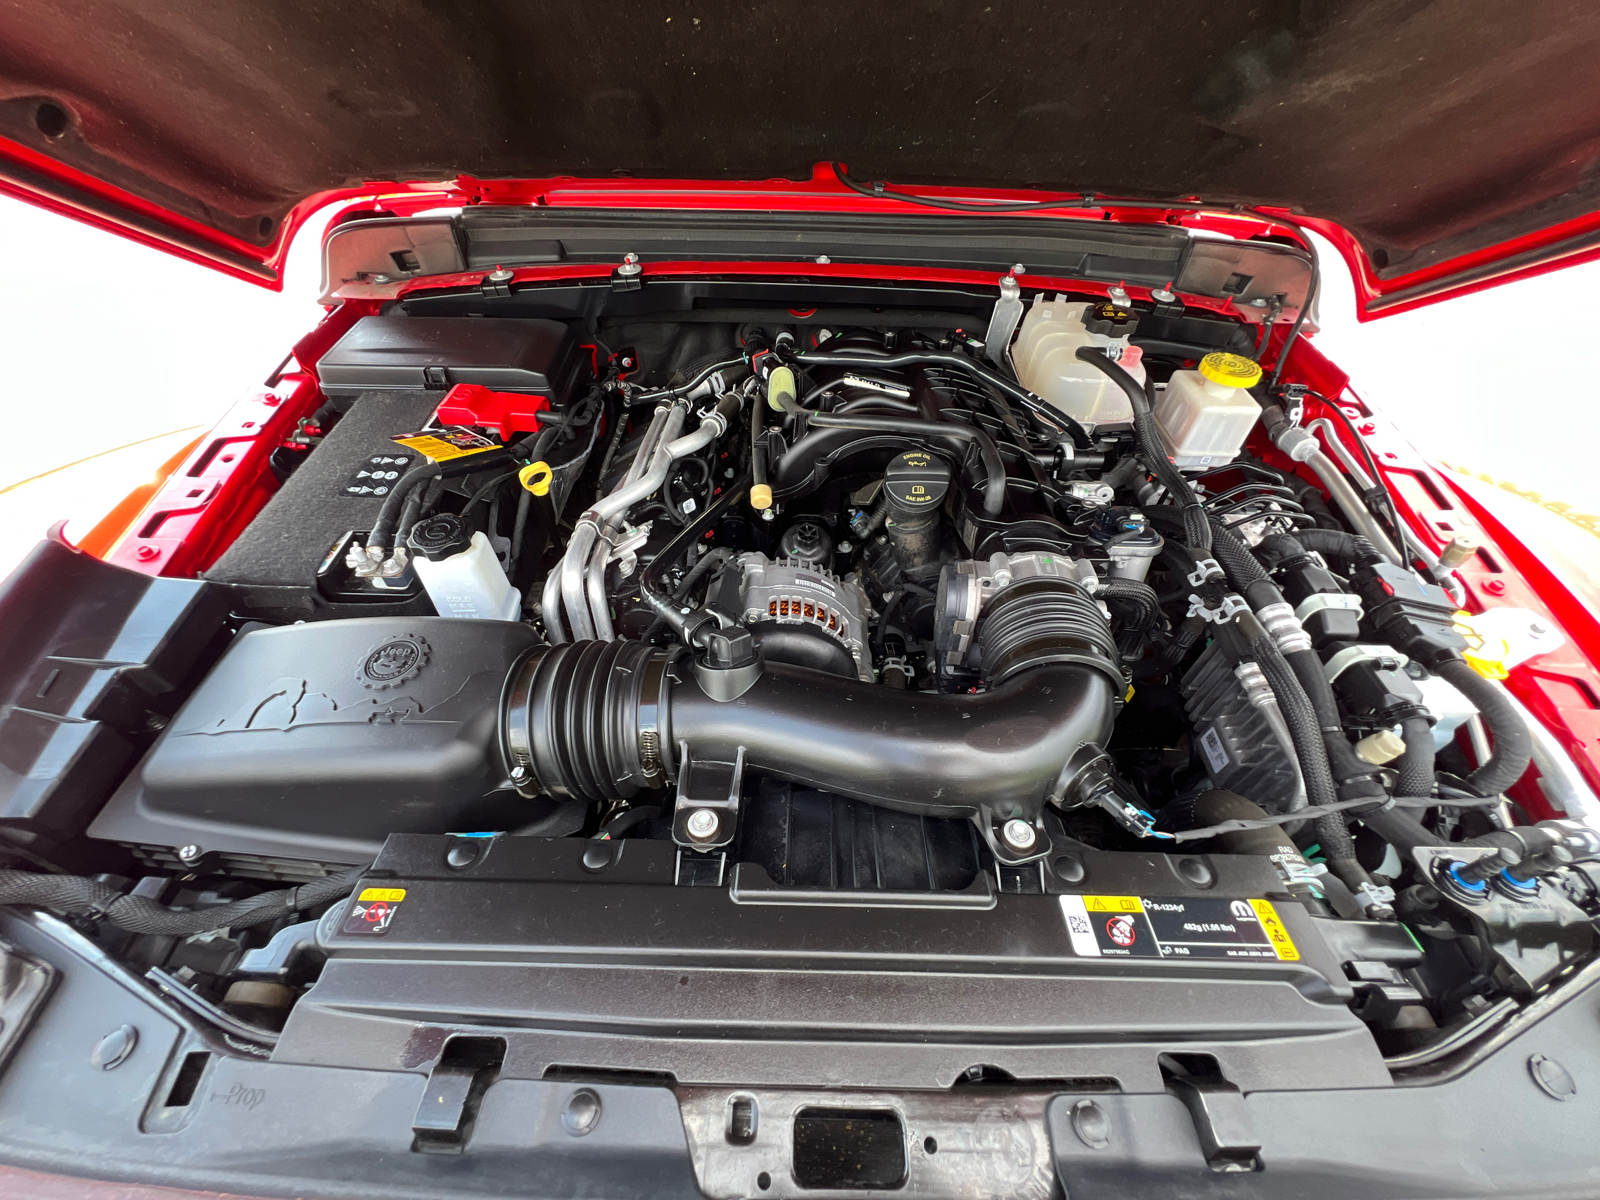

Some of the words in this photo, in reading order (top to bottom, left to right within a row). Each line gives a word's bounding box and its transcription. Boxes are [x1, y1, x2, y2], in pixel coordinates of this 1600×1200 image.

[381, 646, 411, 657] Jeep
[1277, 845, 1294, 854] RAD
[1152, 903, 1185, 913] R-1234yf
[225, 1082, 266, 1111] Prop
